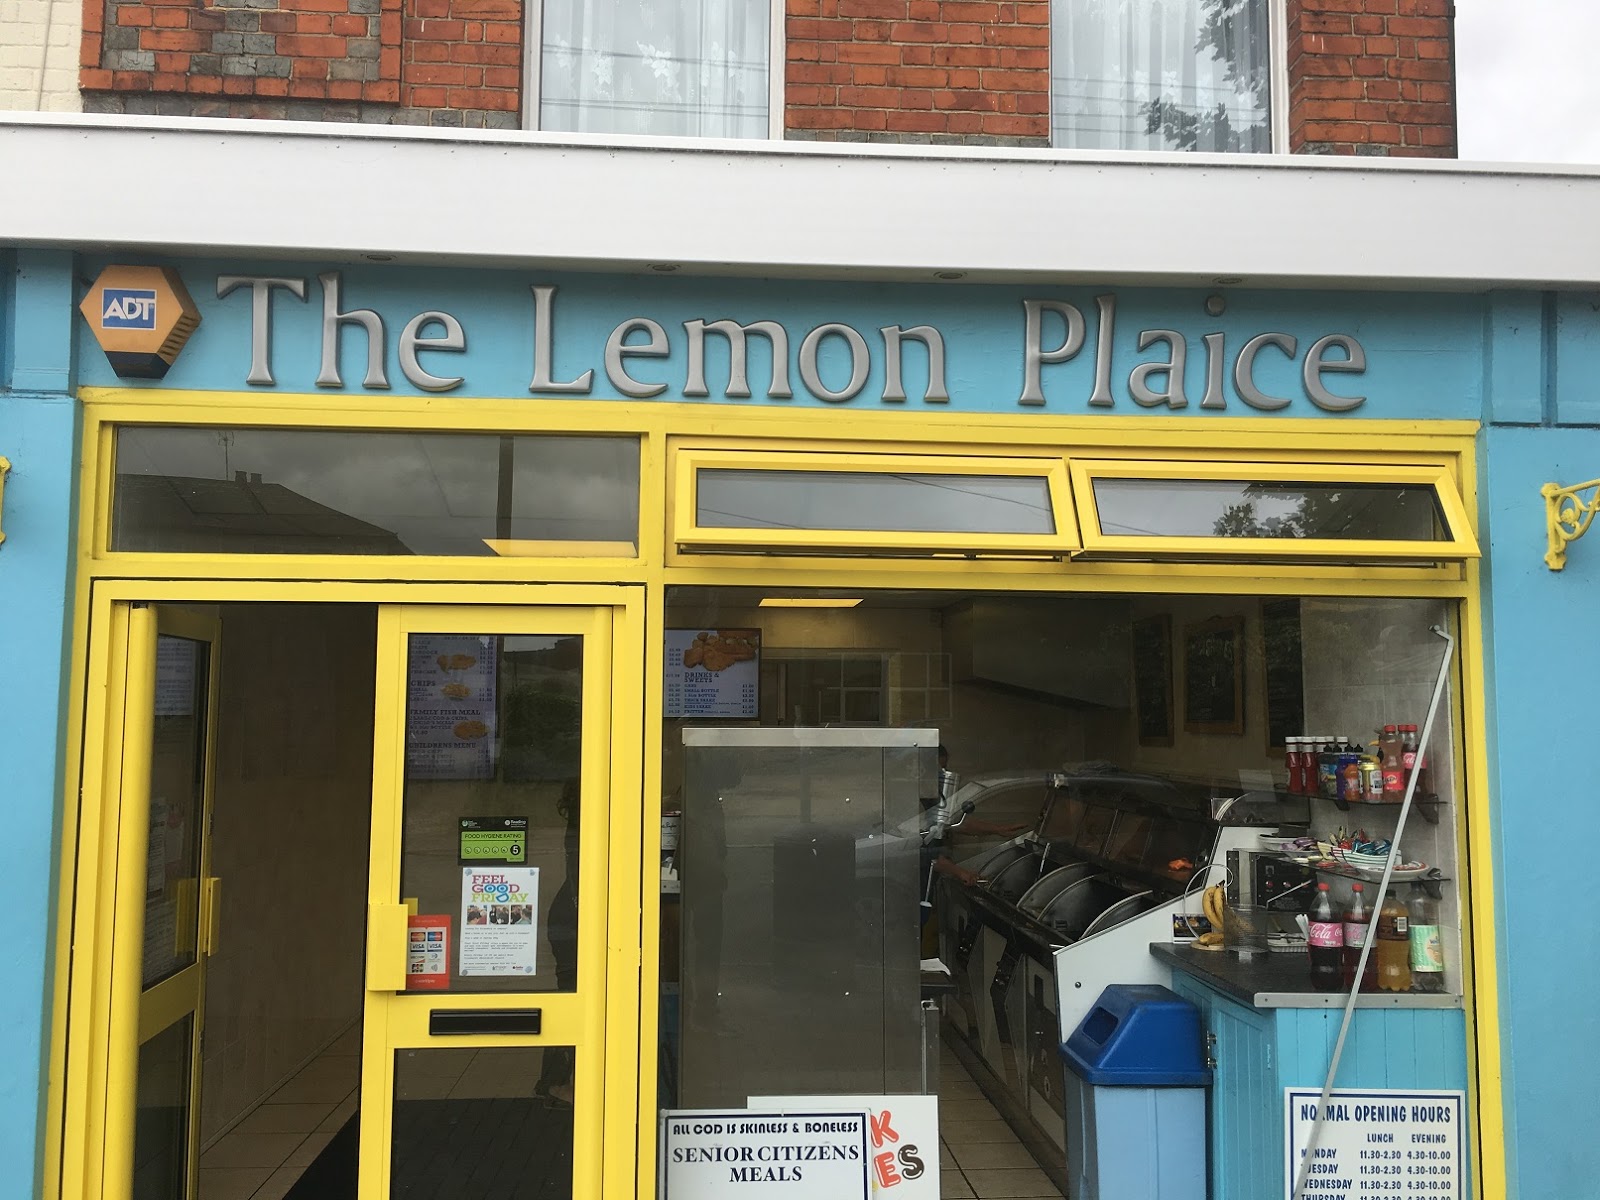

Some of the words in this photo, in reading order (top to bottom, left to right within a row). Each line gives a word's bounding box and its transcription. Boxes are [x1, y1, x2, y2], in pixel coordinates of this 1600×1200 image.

[103, 297, 156, 320] ADT
[216, 272, 467, 392] The
[529, 285, 948, 403] Lemon
[1018, 294, 1367, 411] Plaice
[472, 875, 508, 884] FEEL
[472, 884, 520, 893] GOOD
[471, 893, 529, 903] FRIDAY
[1310, 922, 1333, 939] Cola
[1301, 1104, 1350, 1121] NOMAL
[1354, 1105, 1407, 1122] OPENING
[1412, 1106, 1451, 1123] HOURS
[673, 1123, 690, 1135] ALL
[693, 1123, 723, 1135] COD
[726, 1123, 737, 1134] IS
[740, 1122, 788, 1134] SKINLESS
[792, 1122, 800, 1134] &
[804, 1122, 858, 1133] BONELESS
[1367, 1133, 1393, 1143] LUNCH
[1411, 1133, 1446, 1144] EVENING
[673, 1146, 754, 1163] SENIOR
[758, 1145, 859, 1161] CITIZENS
[1301, 1148, 1337, 1158] MNDAY
[1360, 1150, 1401, 1159] 11.30-2.30
[1407, 1151, 1451, 1160] 4.30-10.00
[729, 1166, 803, 1183] MEALS
[1301, 1164, 1338, 1174] ESDAY
[1360, 1165, 1401, 1174] 11.30-2.30
[1407, 1166, 1451, 1175] 4.30-10.00
[1360, 1181, 1401, 1190] 11.30-2.30
[1407, 1181, 1451, 1190] 4.30-10.00
